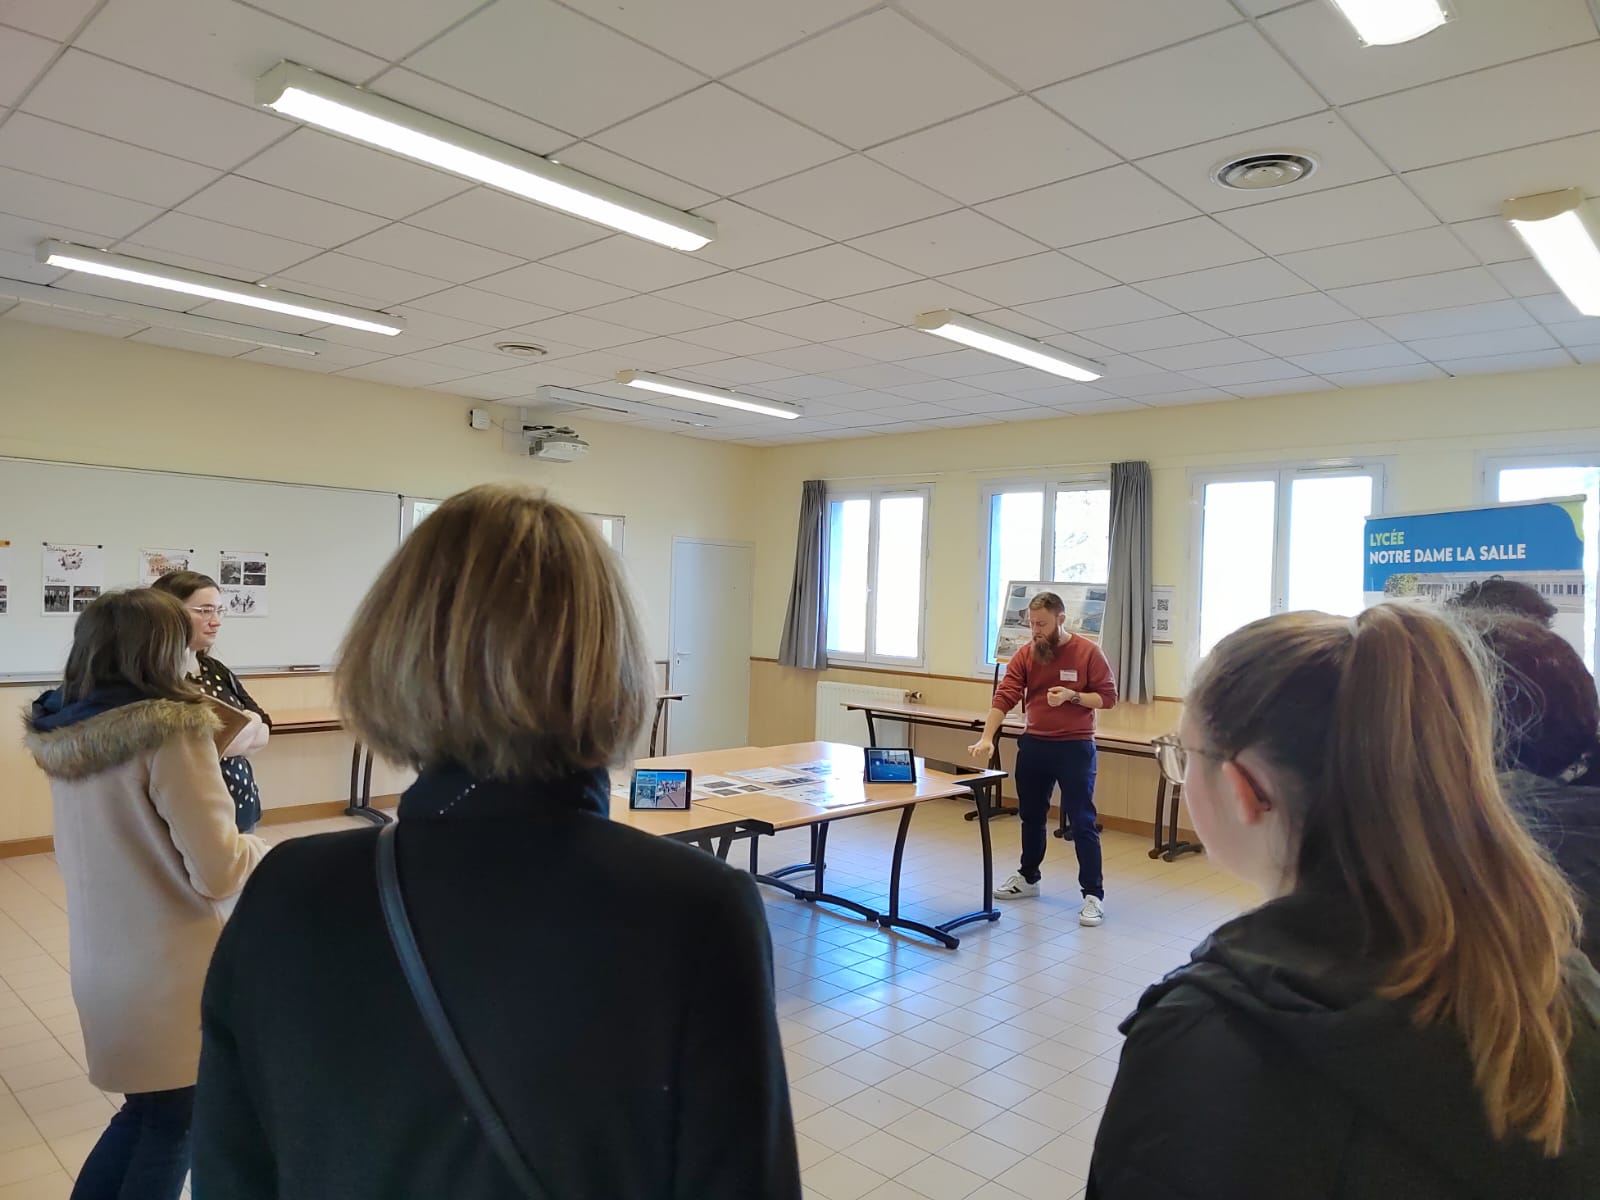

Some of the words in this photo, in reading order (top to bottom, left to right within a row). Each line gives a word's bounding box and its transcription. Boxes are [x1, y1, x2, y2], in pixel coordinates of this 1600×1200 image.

[1369, 529, 1405, 547] LYCÉE
[1369, 549, 1411, 565] NOTRE
[1414, 547, 1453, 563] DAME
[1456, 546, 1476, 562] LA
[1479, 543, 1527, 561] SALLE
